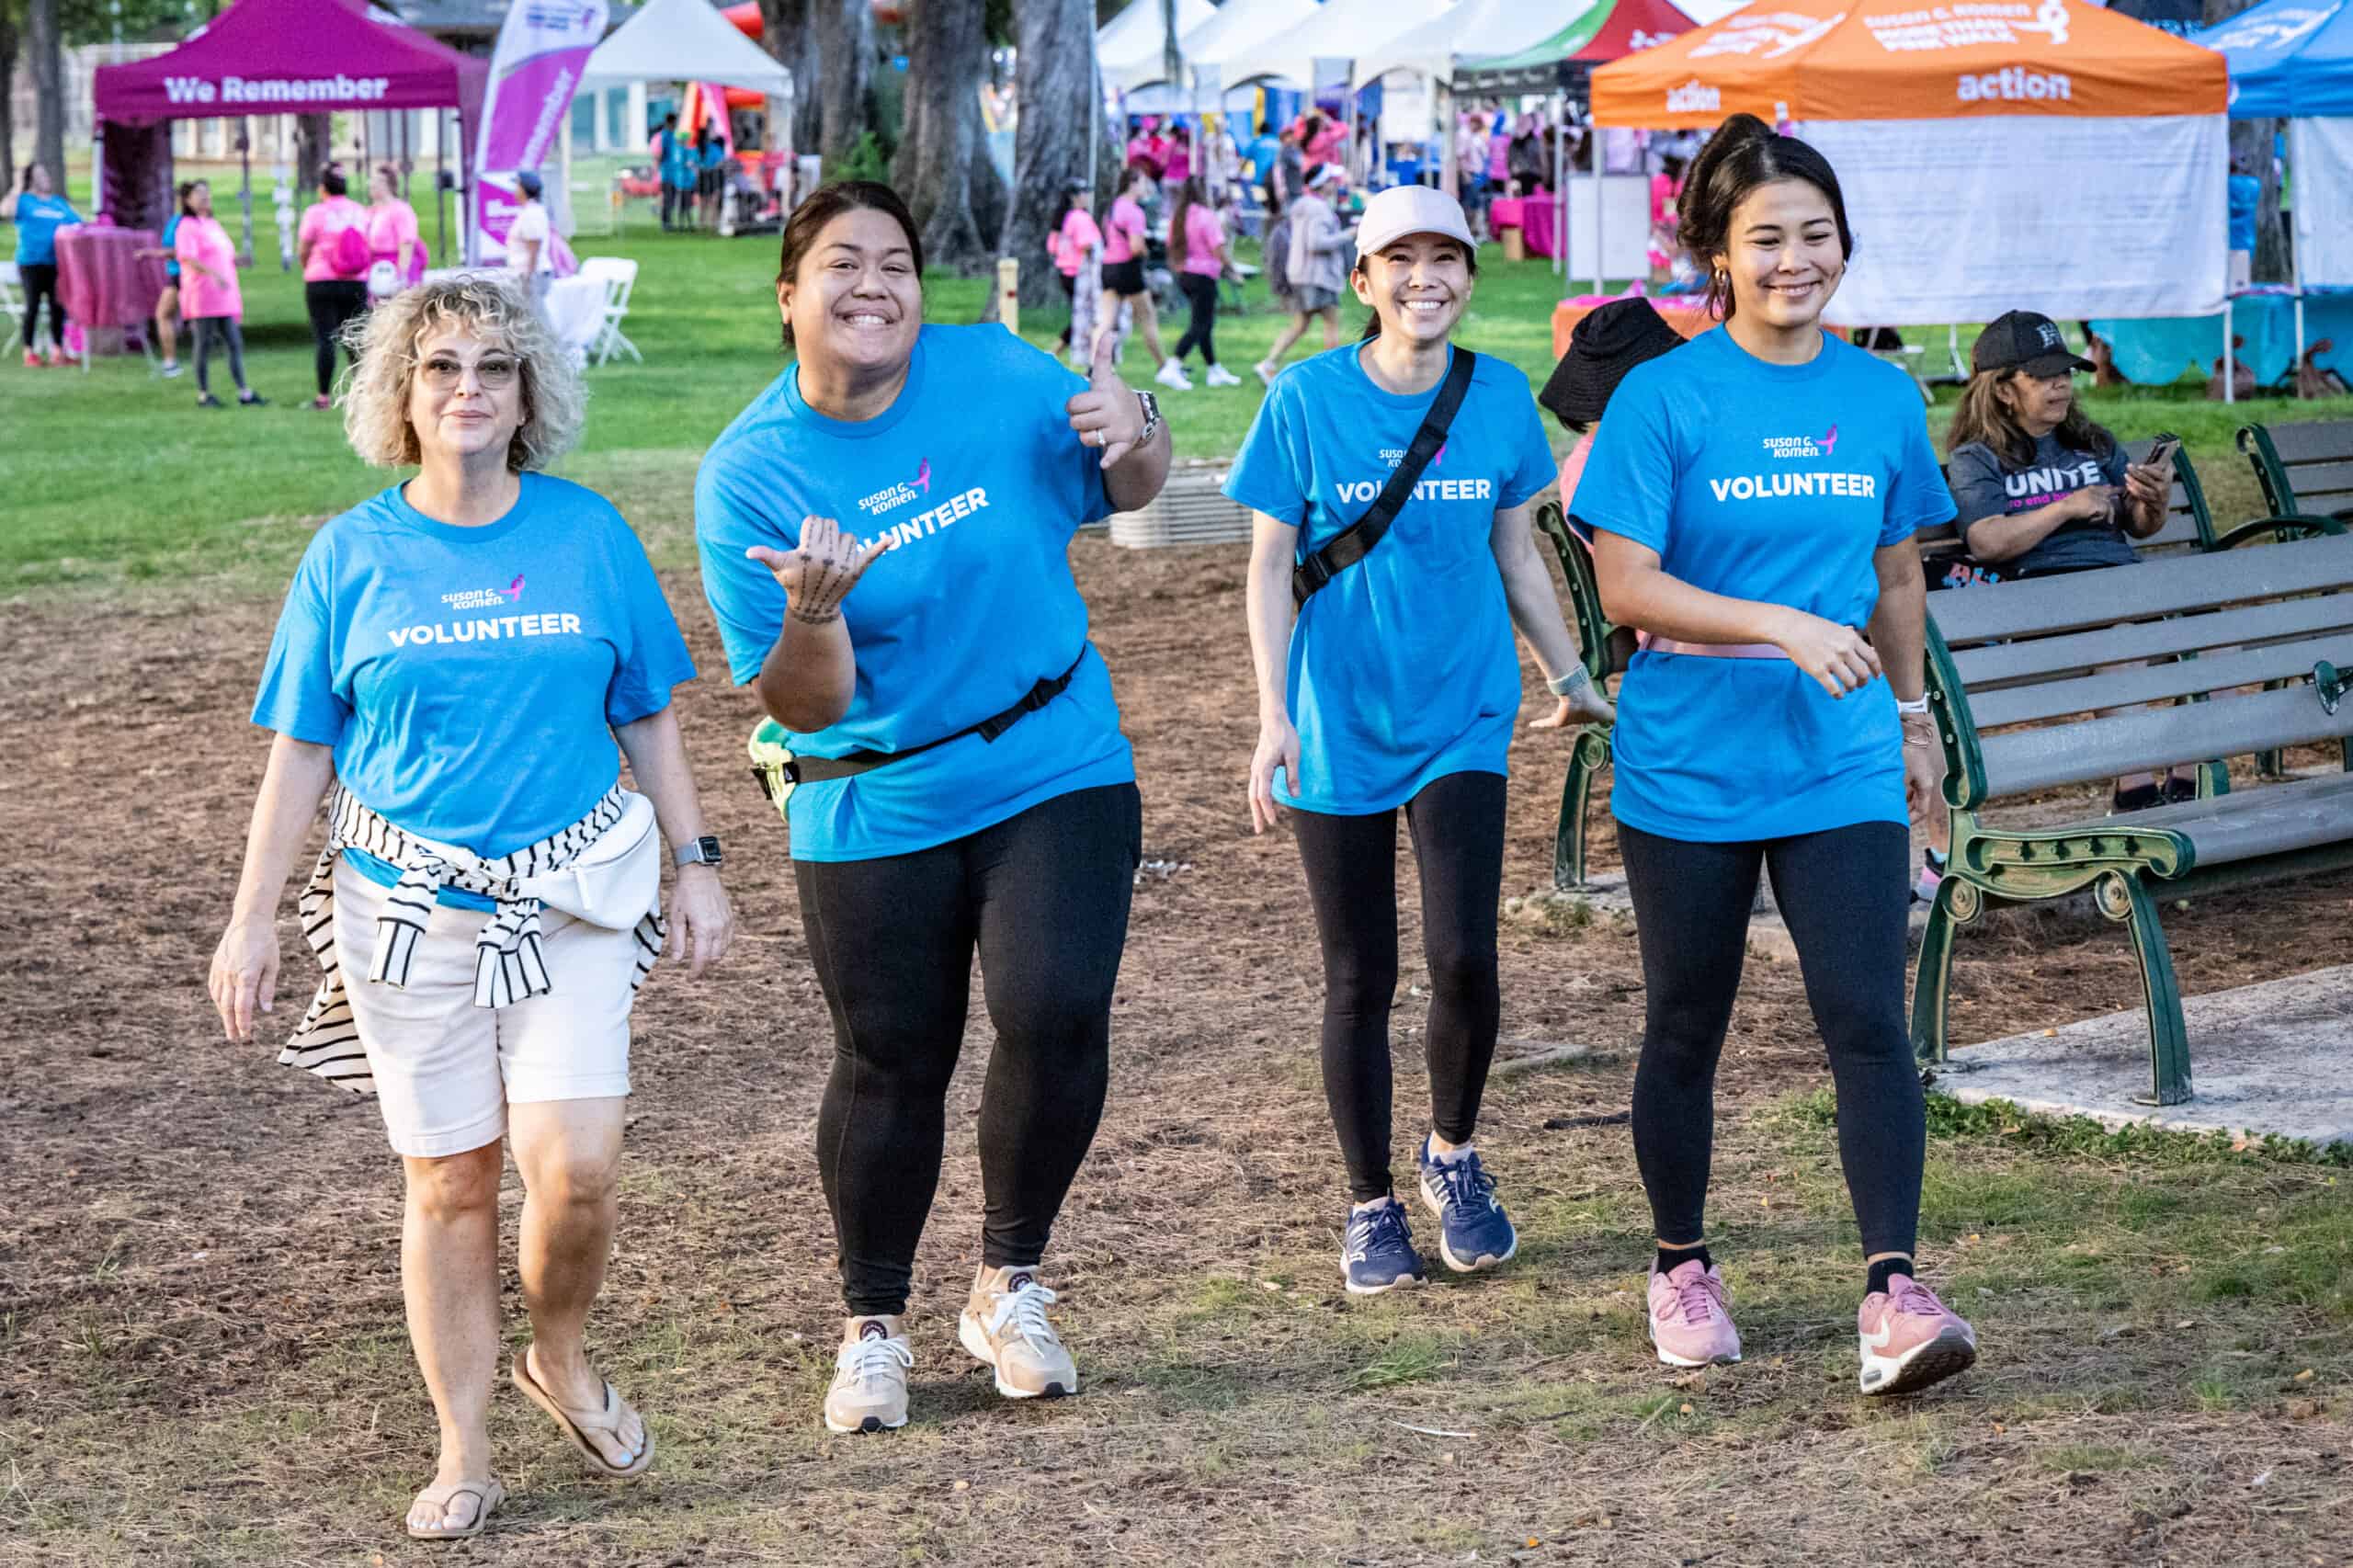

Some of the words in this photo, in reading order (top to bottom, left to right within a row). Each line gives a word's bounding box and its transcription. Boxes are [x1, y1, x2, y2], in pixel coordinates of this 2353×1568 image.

[164, 75, 216, 103] We
[222, 74, 389, 103] Remember
[1957, 65, 2072, 101] action
[1379, 449, 1407, 459] susa
[1336, 479, 1491, 504] VONTEER
[1710, 472, 1875, 502] VOLUNTEER
[2006, 460, 2100, 496] UNITE
[857, 487, 990, 555] UNTEER
[388, 613, 581, 648] VOLUNTEER
